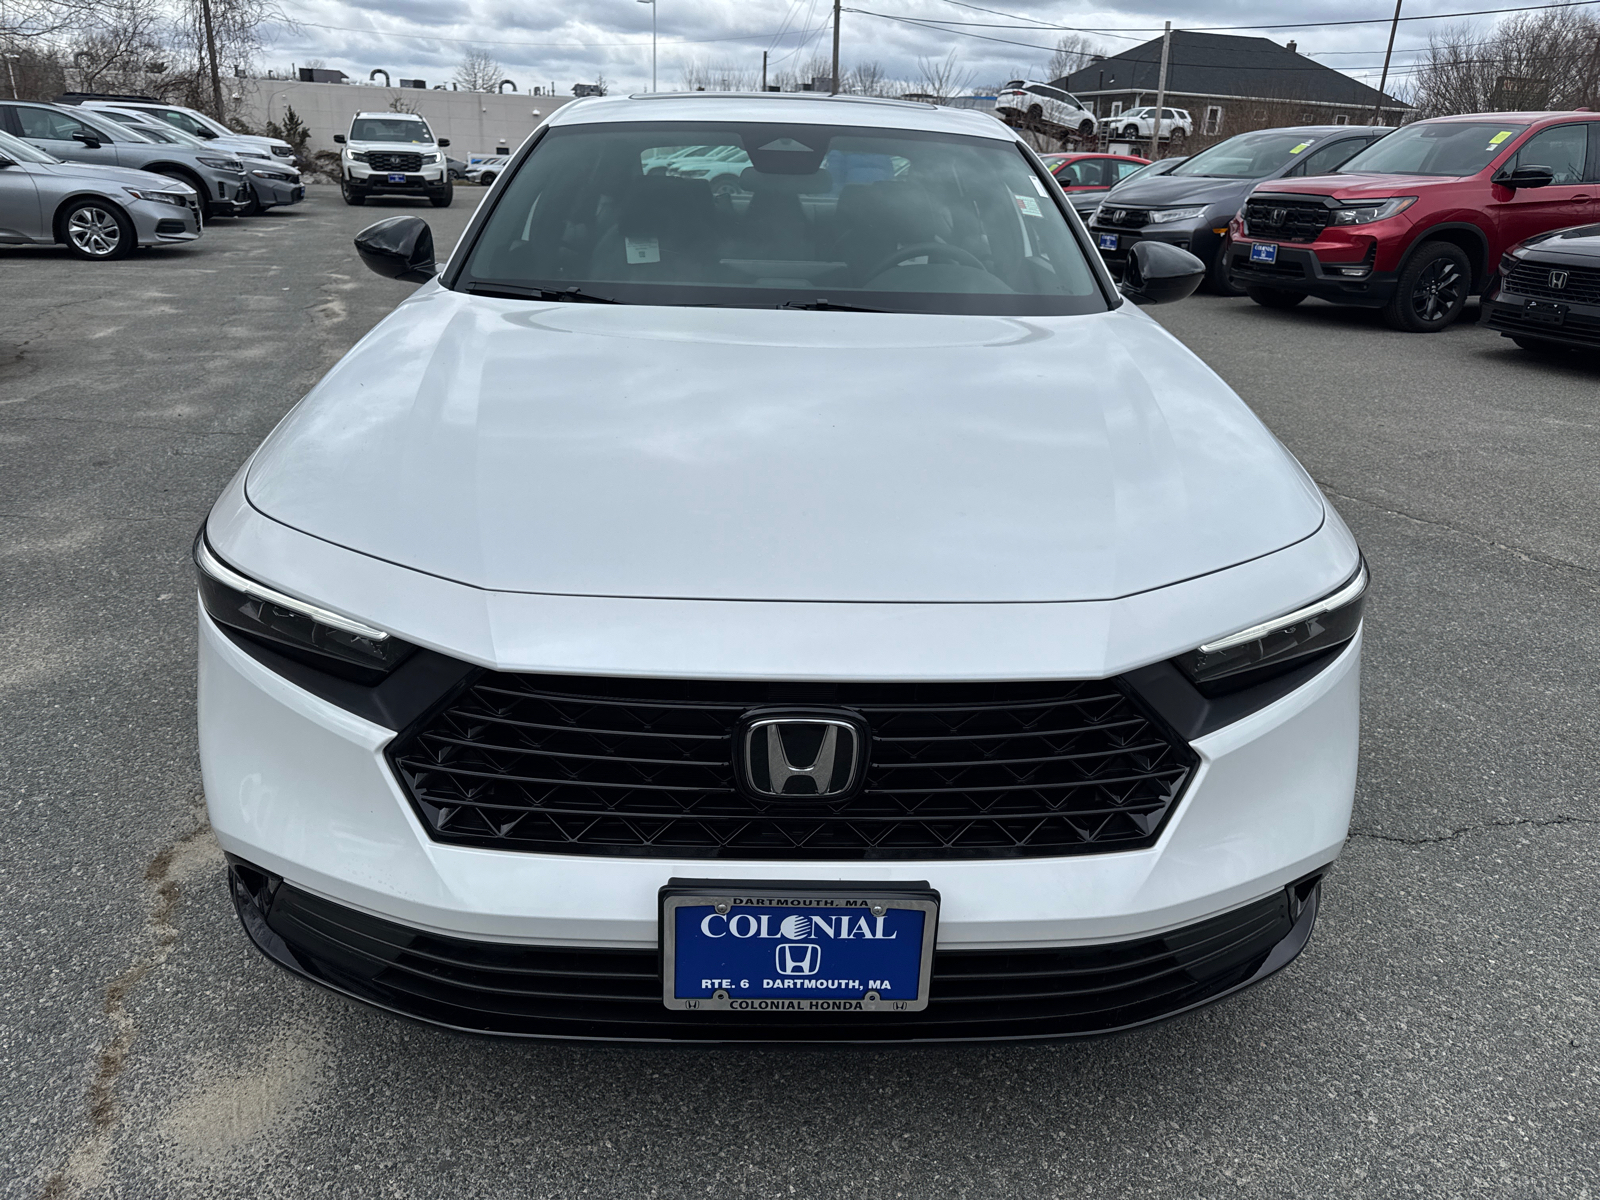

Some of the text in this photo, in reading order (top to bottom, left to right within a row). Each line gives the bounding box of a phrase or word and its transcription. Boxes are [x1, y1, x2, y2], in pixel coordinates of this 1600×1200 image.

[733, 898, 839, 907] DARTMOUTH,
[701, 913, 898, 940] COLONIAL
[701, 979, 892, 990] RTE. 6 DARTMOUTH, MA
[729, 1000, 864, 1010] COLONIAL HONDA
